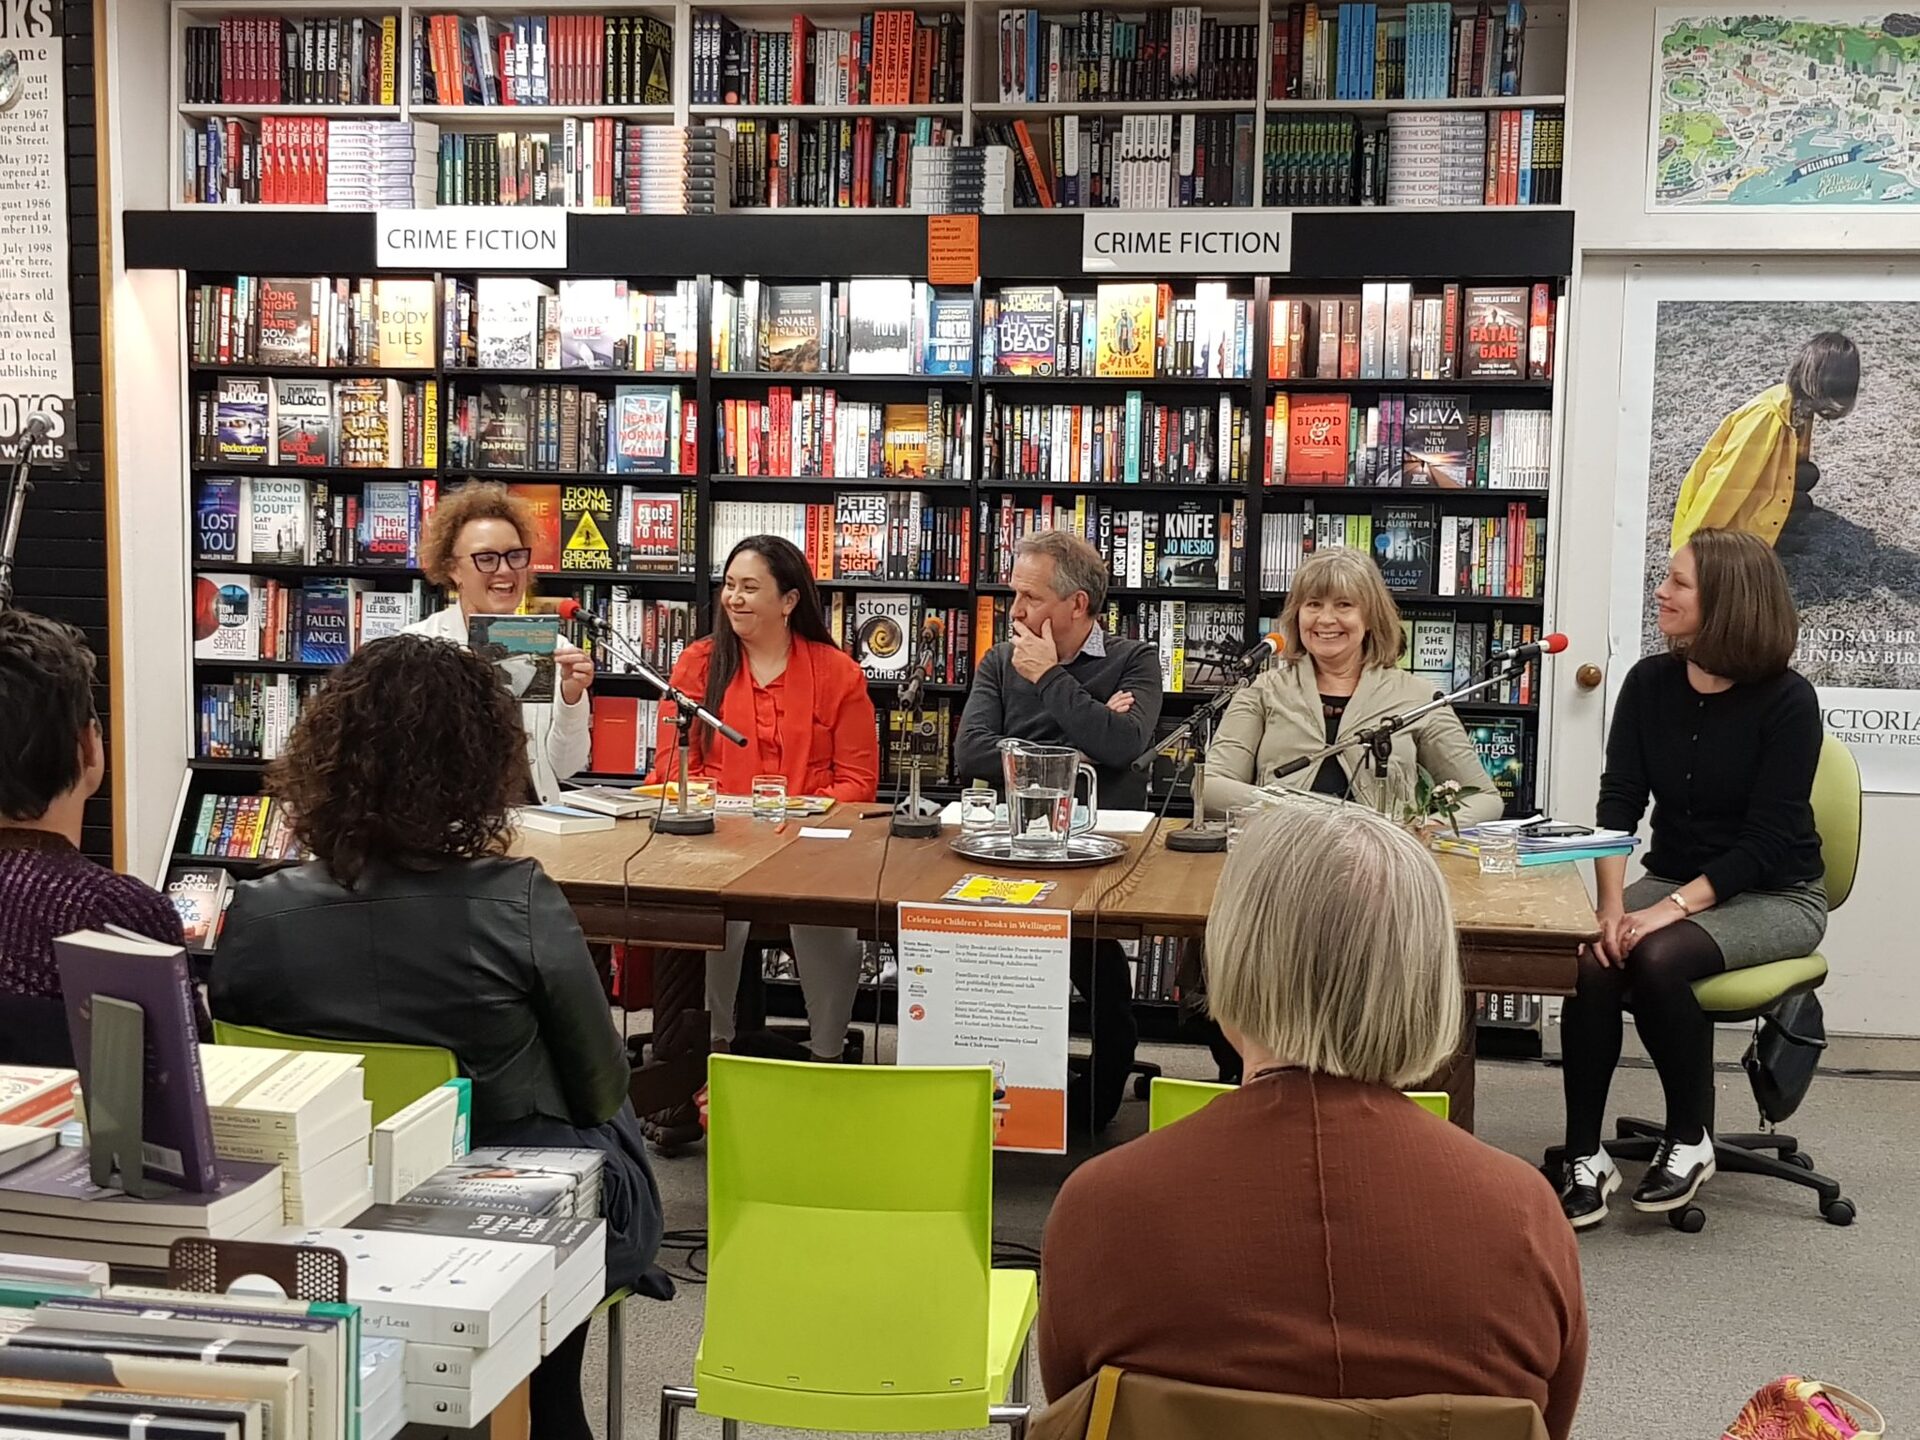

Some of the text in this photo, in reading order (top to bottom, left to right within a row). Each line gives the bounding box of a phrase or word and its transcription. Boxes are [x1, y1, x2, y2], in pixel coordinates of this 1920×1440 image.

[759, 37, 767, 59] REAL
[875, 14, 885, 79] PETER JAMES
[888, 14, 899, 79] PETER JAMES
[901, 14, 911, 79] PETER JAMES
[19, 48, 47, 61] me
[384, 30, 393, 90] CARRIER
[27, 74, 48, 84] out
[24, 109, 49, 120] 1967
[1419, 114, 1439, 123] LIONS
[1, 123, 49, 136] opened at
[565, 122, 574, 146] KILL
[16, 135, 49, 145] Street.
[778, 123, 789, 167] SEVERED
[25, 154, 49, 165] 1972
[1799, 153, 1850, 177] WELLINGTON
[2, 167, 50, 179] opened at
[34, 180, 51, 190] 42.
[26, 199, 51, 209] 1986
[4, 212, 51, 223] opened at
[30, 225, 52, 235] 119.
[387, 229, 557, 251] CRIME FICTION
[1094, 232, 1280, 253] CRIME FICTION
[3, 243, 53, 254] July 1998
[20, 269, 53, 279] Street.
[263, 281, 271, 291] A
[35, 289, 54, 301] old
[263, 292, 296, 301] LONG
[1008, 294, 1044, 303] STUART
[263, 301, 298, 311] NIGHT
[1000, 303, 1053, 312] MACBRIDE
[43, 312, 55, 323] &
[263, 312, 274, 320] IN
[382, 311, 429, 324] BODY
[777, 316, 815, 326] SNAKE
[1002, 315, 1022, 325] ALL
[262, 320, 297, 329] PARIS
[936, 321, 971, 338] FOREVER
[16, 327, 56, 339] owned
[261, 328, 286, 338] DOV
[573, 326, 602, 336] WIFE
[774, 326, 818, 337] ISLAND
[998, 324, 1055, 339] THAT'S
[1469, 327, 1519, 342] FATAL
[261, 338, 299, 347] ALFON
[388, 332, 423, 345] LIES
[1001, 337, 1050, 352] DEAD
[11, 349, 57, 361] to local
[1479, 345, 1518, 359] GAME
[219, 393, 268, 403] BALDACCI
[280, 396, 327, 406] BALDACCI
[1418, 400, 1456, 409] DANIEL
[1297, 416, 1342, 426] BLOOD
[1409, 409, 1464, 424] SILVA
[427, 398, 436, 454] CARRIER
[1309, 420, 1330, 441] &
[619, 430, 668, 441] NORMAL
[1294, 436, 1342, 446] SUGAR
[1424, 437, 1447, 445] NEW
[219, 443, 267, 454] Redemption
[1424, 445, 1446, 454] GIRL
[297, 453, 326, 465] Deed
[253, 483, 301, 493] BEYOND
[565, 487, 607, 500] FIONA
[254, 495, 301, 504] REASONABLE
[561, 499, 613, 512] ERSKINE
[837, 497, 886, 510] PETER
[254, 504, 294, 515] DOUBT
[638, 504, 673, 520] CLOSE
[201, 514, 237, 530] LOST
[374, 515, 406, 527] Their
[835, 510, 886, 524] JAMES
[842, 524, 878, 535] DEAD
[1165, 513, 1214, 538] KNIFE
[1375, 520, 1431, 529] SLAUGHTER
[373, 527, 408, 540] Little
[635, 525, 675, 539] TO THE
[821, 505, 830, 560] PETER JAMES
[200, 532, 236, 551] YOU
[370, 541, 407, 553] Secre
[1164, 539, 1215, 555] JO NESBO
[562, 551, 613, 562] CHEMICAL
[841, 547, 878, 559] FIRST
[562, 560, 613, 570] DETECTIVE
[839, 559, 880, 572] SIGHT
[1112, 549, 1126, 576] NESBO
[1144, 552, 1156, 576] NESBO
[1399, 570, 1423, 578] LAST
[372, 596, 396, 605] JAMES
[219, 604, 234, 614] TOM
[366, 605, 402, 615] LEE BURKE
[858, 601, 909, 616] stone
[219, 614, 248, 624] BRADBY
[306, 616, 346, 628] FALLEN
[1189, 610, 1245, 624] THE PARIS
[1173, 603, 1185, 649] HUSH HUSH
[1417, 626, 1452, 634] BEFORE
[217, 629, 247, 639] SECRET
[307, 632, 346, 645] ANGEL
[1189, 625, 1245, 641] DIVERSION
[1797, 628, 1879, 643] LINDSAY
[213, 639, 247, 650] SERVICE
[1424, 637, 1444, 645] SHE
[1419, 648, 1448, 656] KNEW
[1797, 650, 1920, 665] LINDSAY BIR
[1423, 658, 1444, 667] HIM
[1492, 733, 1514, 743] Fred
[1832, 732, 1885, 744] ERSITY
[181, 874, 208, 883] JOHN
[169, 882, 218, 892] CONNOLLY
[906, 914, 1062, 932] Celebrate Children's Books in Wellington
[386, 1316, 411, 1328] Less
